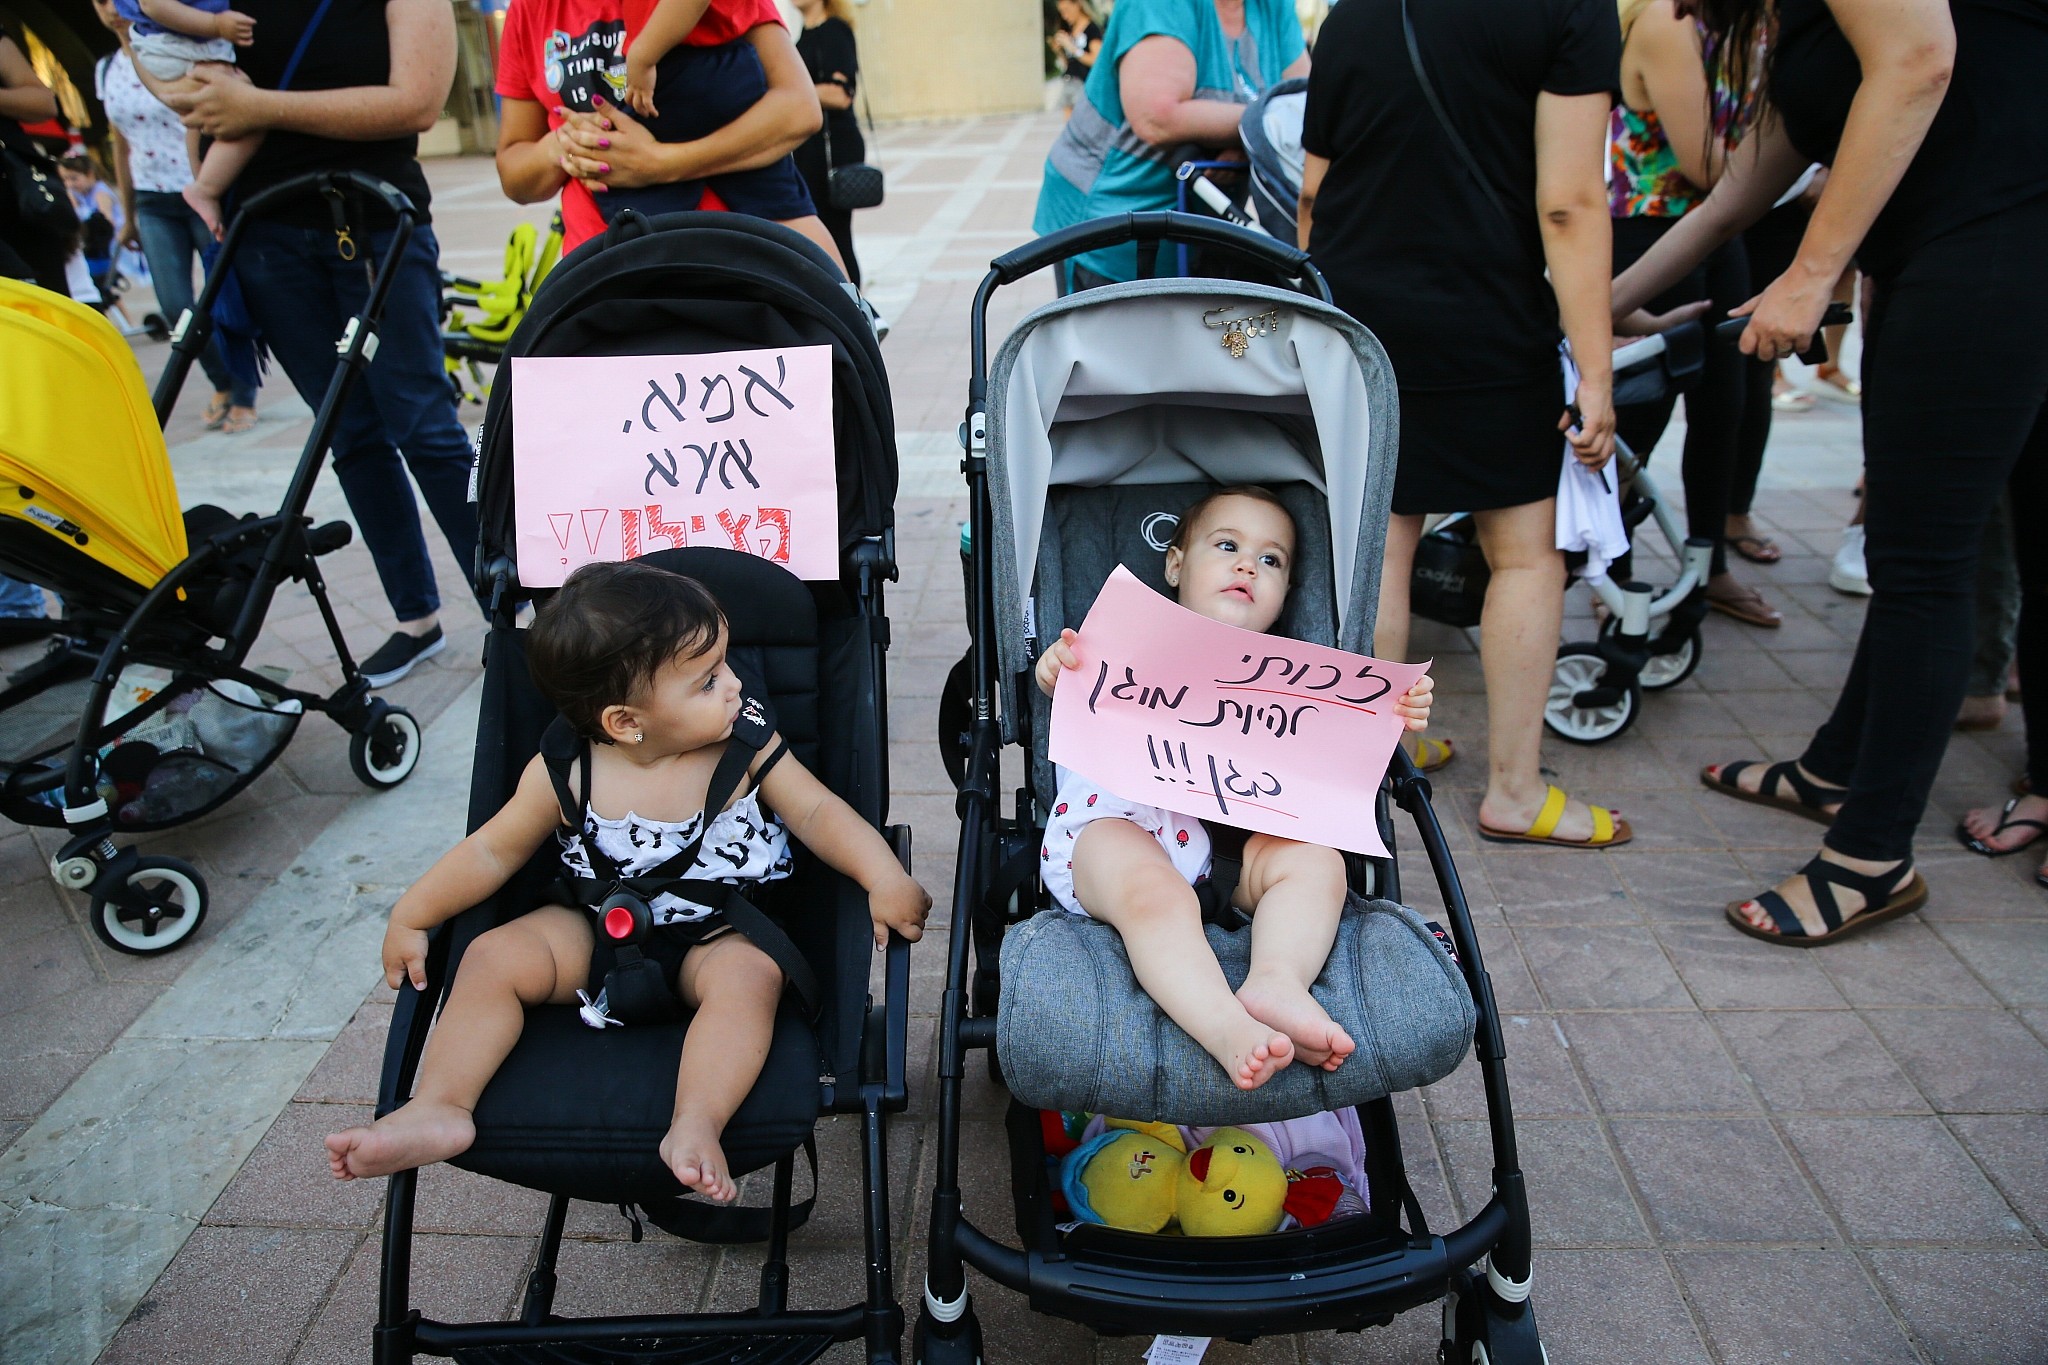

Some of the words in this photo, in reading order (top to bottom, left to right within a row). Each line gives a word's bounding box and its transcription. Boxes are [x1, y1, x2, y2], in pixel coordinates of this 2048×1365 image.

[567, 57, 606, 76] TIME
[571, 86, 588, 103] IS
[1088, 660, 1189, 714] מוגן
[1178, 699, 1319, 738] להיות
